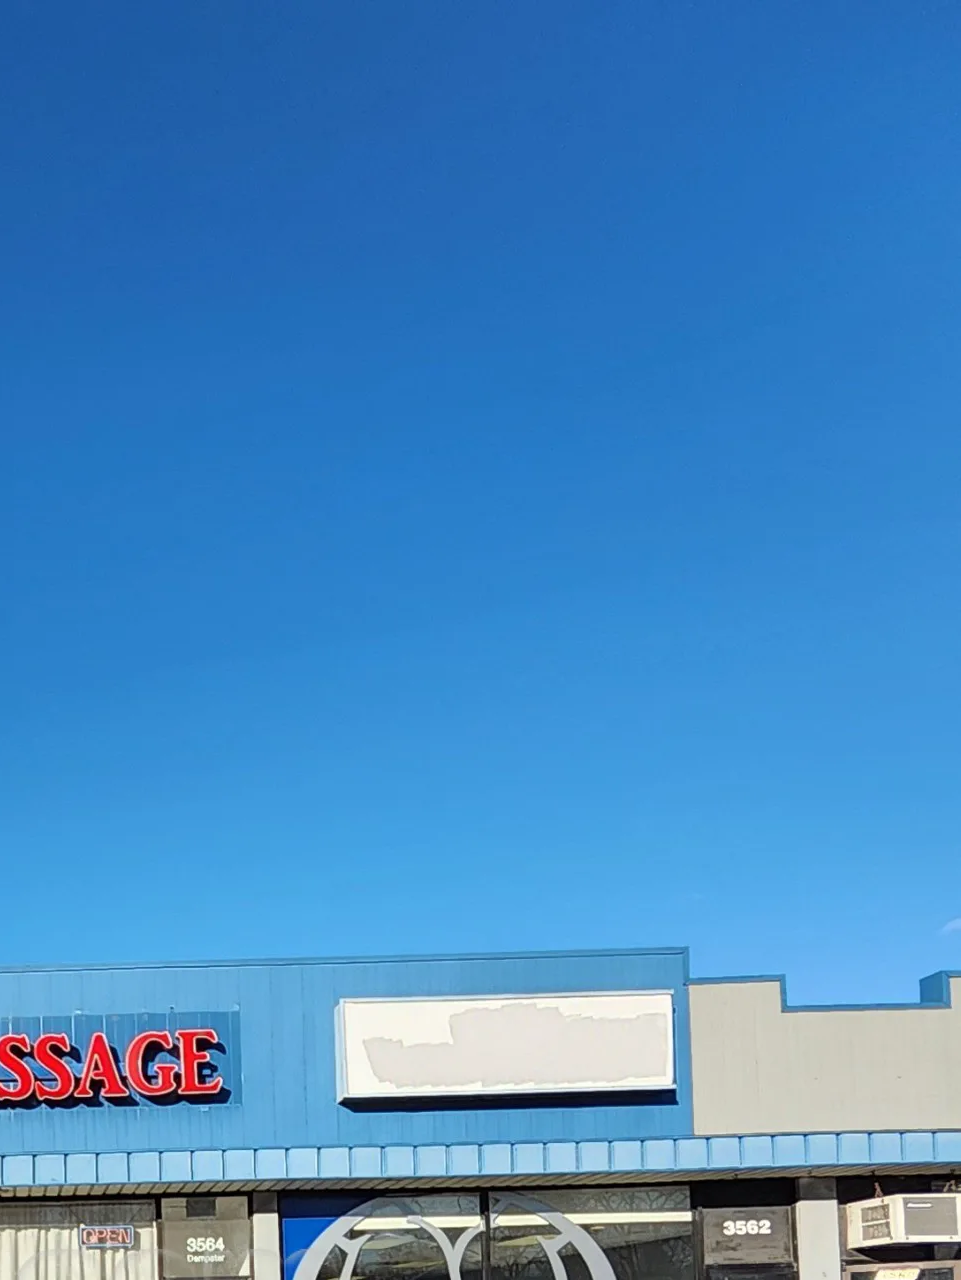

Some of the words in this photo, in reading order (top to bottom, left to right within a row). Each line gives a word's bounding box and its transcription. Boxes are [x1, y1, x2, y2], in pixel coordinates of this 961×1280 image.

[723, 1220, 772, 1236] 3562
[83, 1228, 131, 1244] OPEN
[187, 1237, 225, 1252] 3564
[187, 1254, 226, 1264] Dempster
